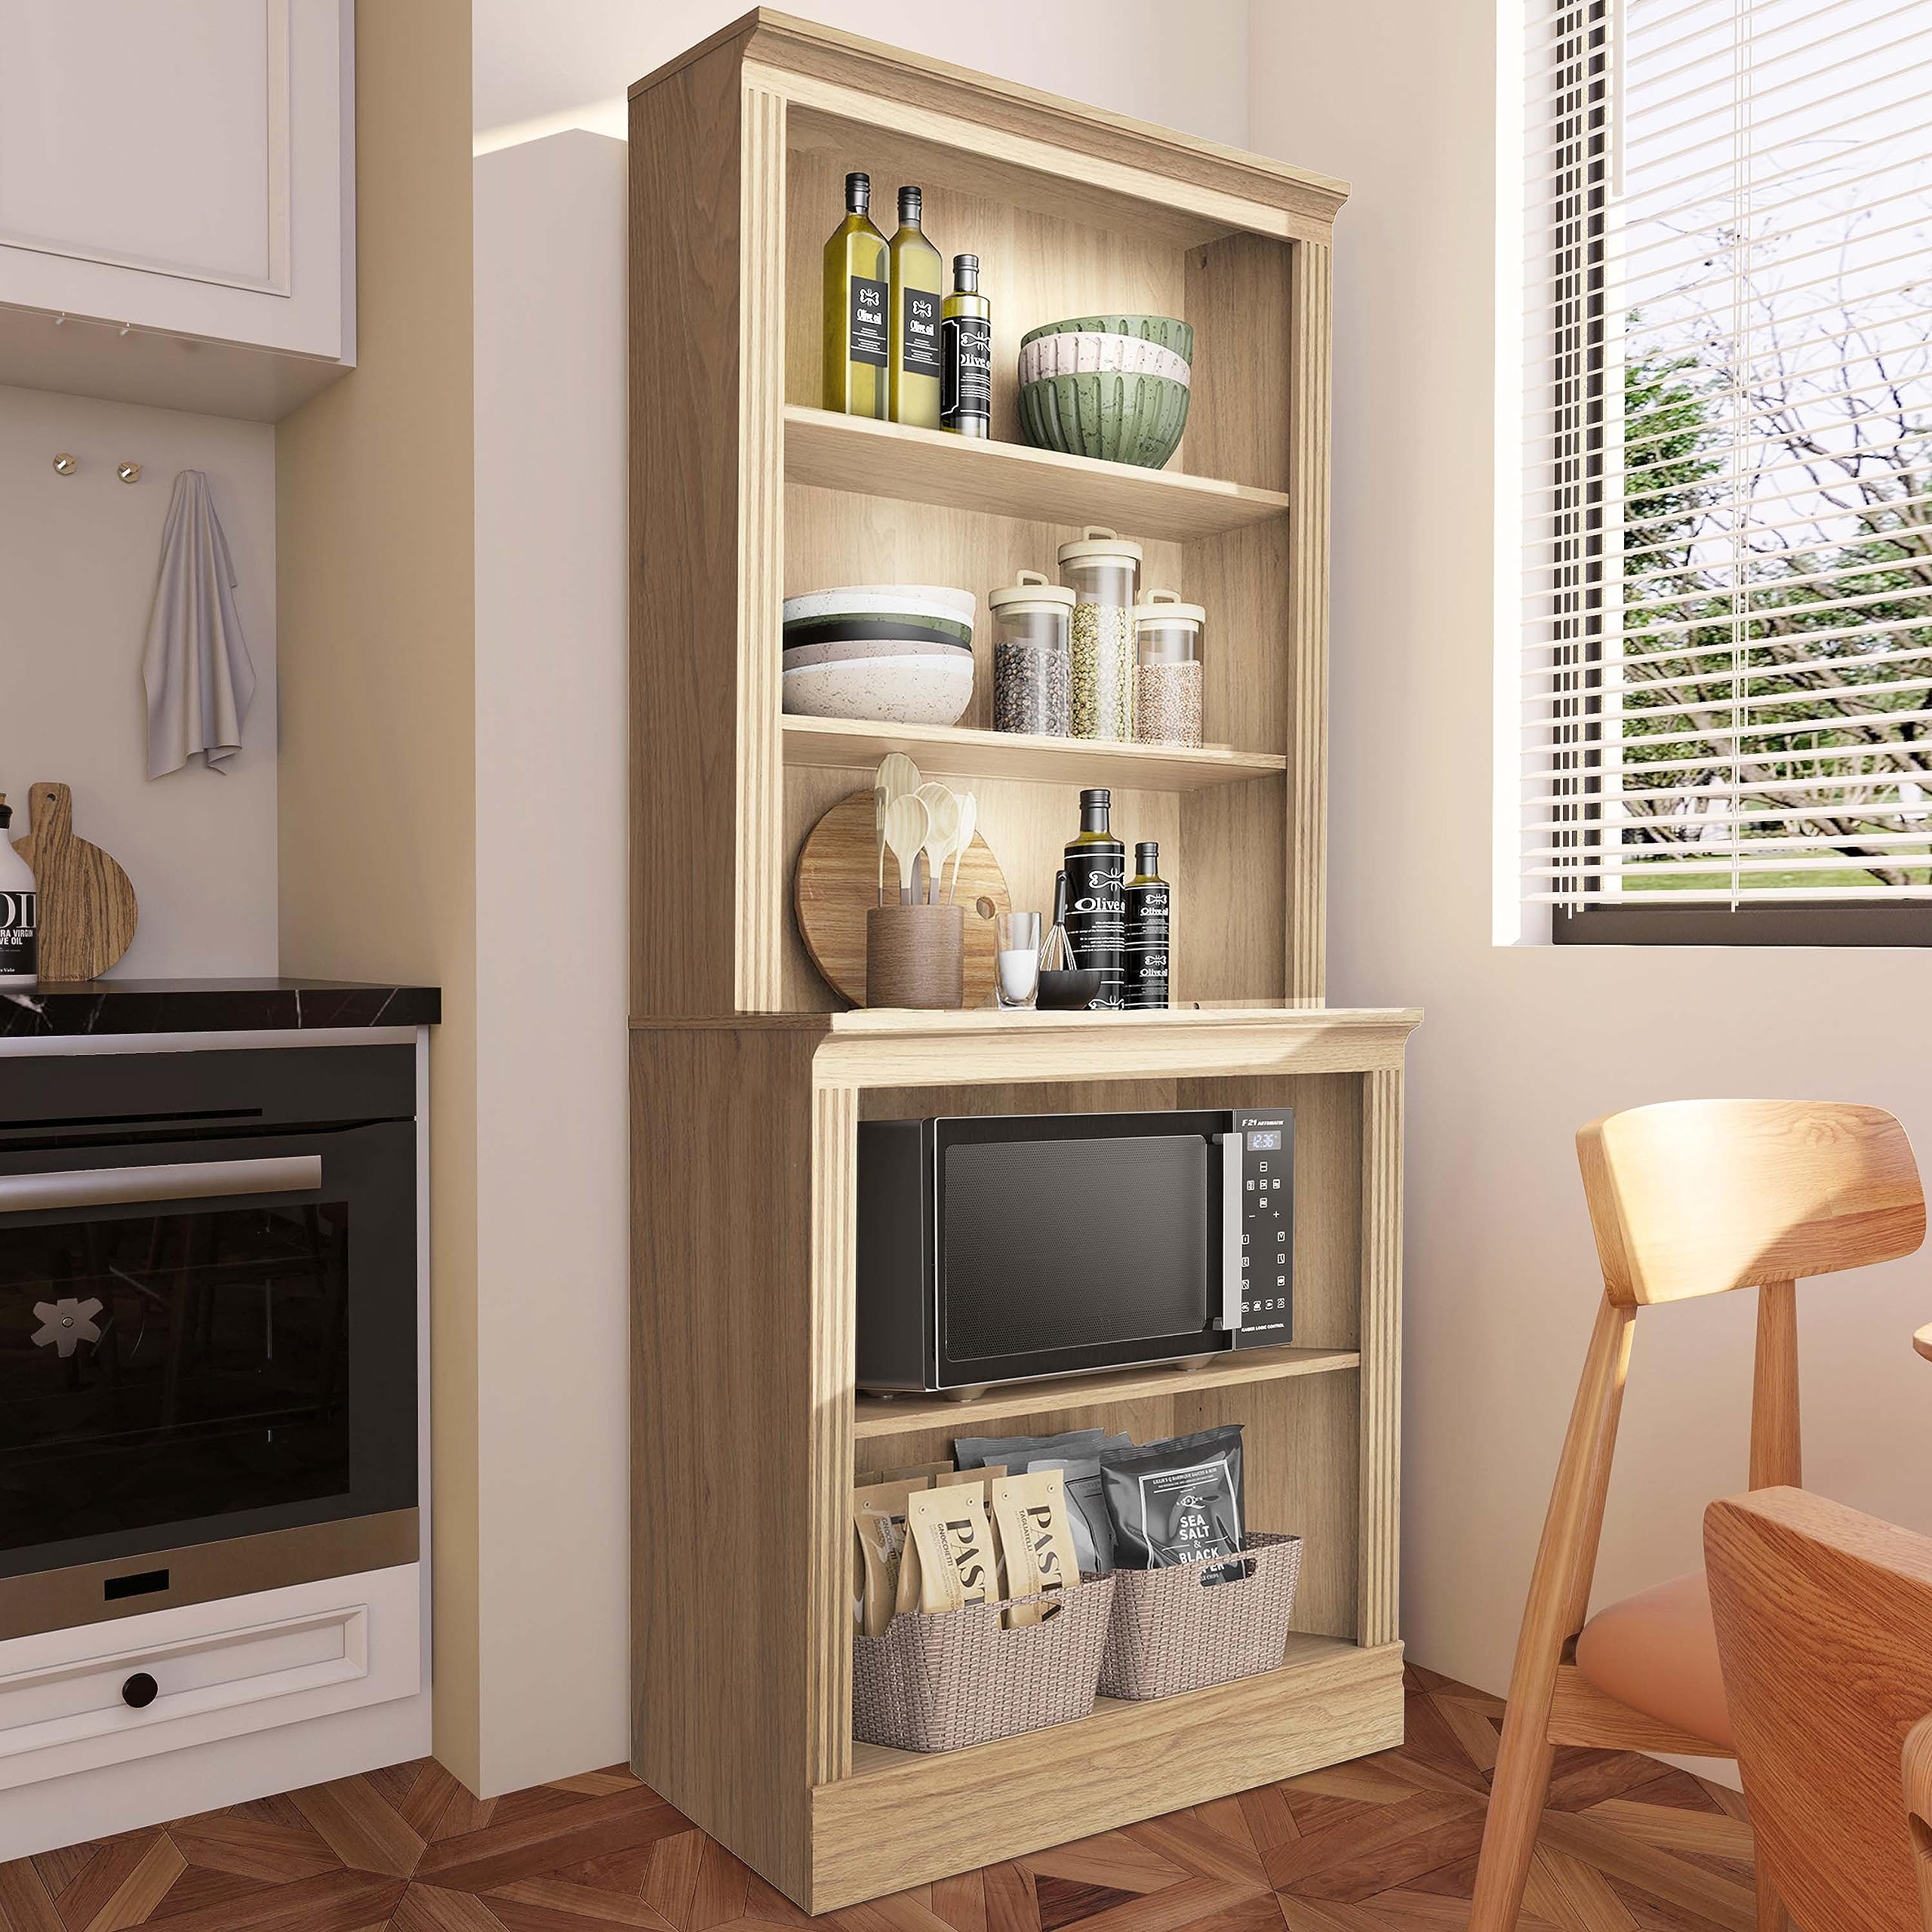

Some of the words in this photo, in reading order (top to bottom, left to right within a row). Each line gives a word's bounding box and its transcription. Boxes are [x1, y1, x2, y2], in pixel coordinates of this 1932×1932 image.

[1075, 897, 1120, 912] Olive
[1180, 1514, 1206, 1528] SEA
[1179, 1525, 1210, 1541] SALT
[1193, 1540, 1202, 1549] &
[946, 1518, 986, 1607] PAST
[1178, 1547, 1220, 1564] BLACK
